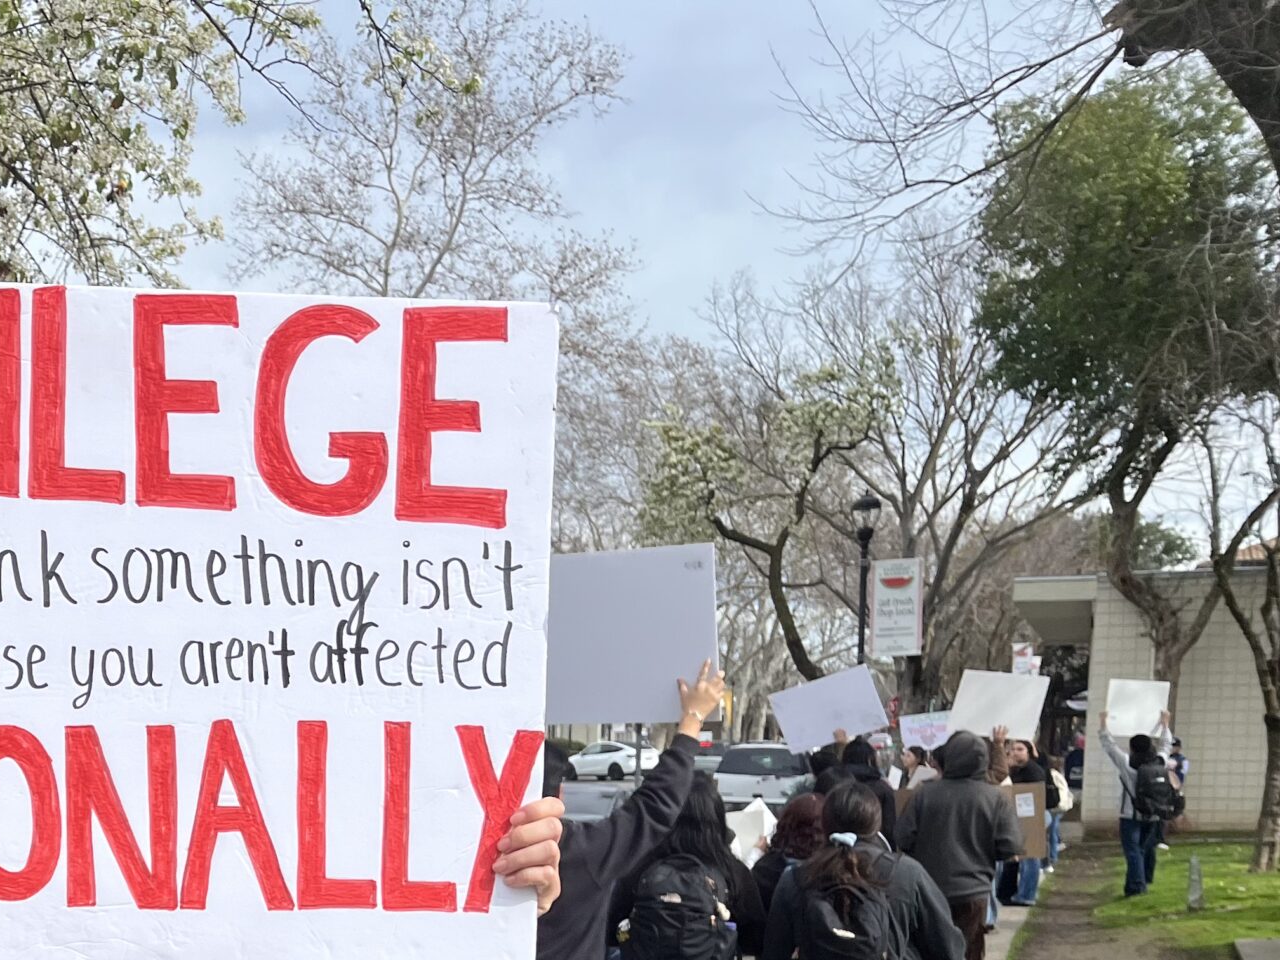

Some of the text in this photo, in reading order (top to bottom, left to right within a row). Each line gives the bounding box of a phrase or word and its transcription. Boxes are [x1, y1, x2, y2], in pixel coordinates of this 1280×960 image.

[91, 535, 380, 635] something
[403, 540, 523, 611] isn't
[71, 645, 163, 709] you
[180, 628, 296, 688] aren't
[309, 619, 513, 690] affected
